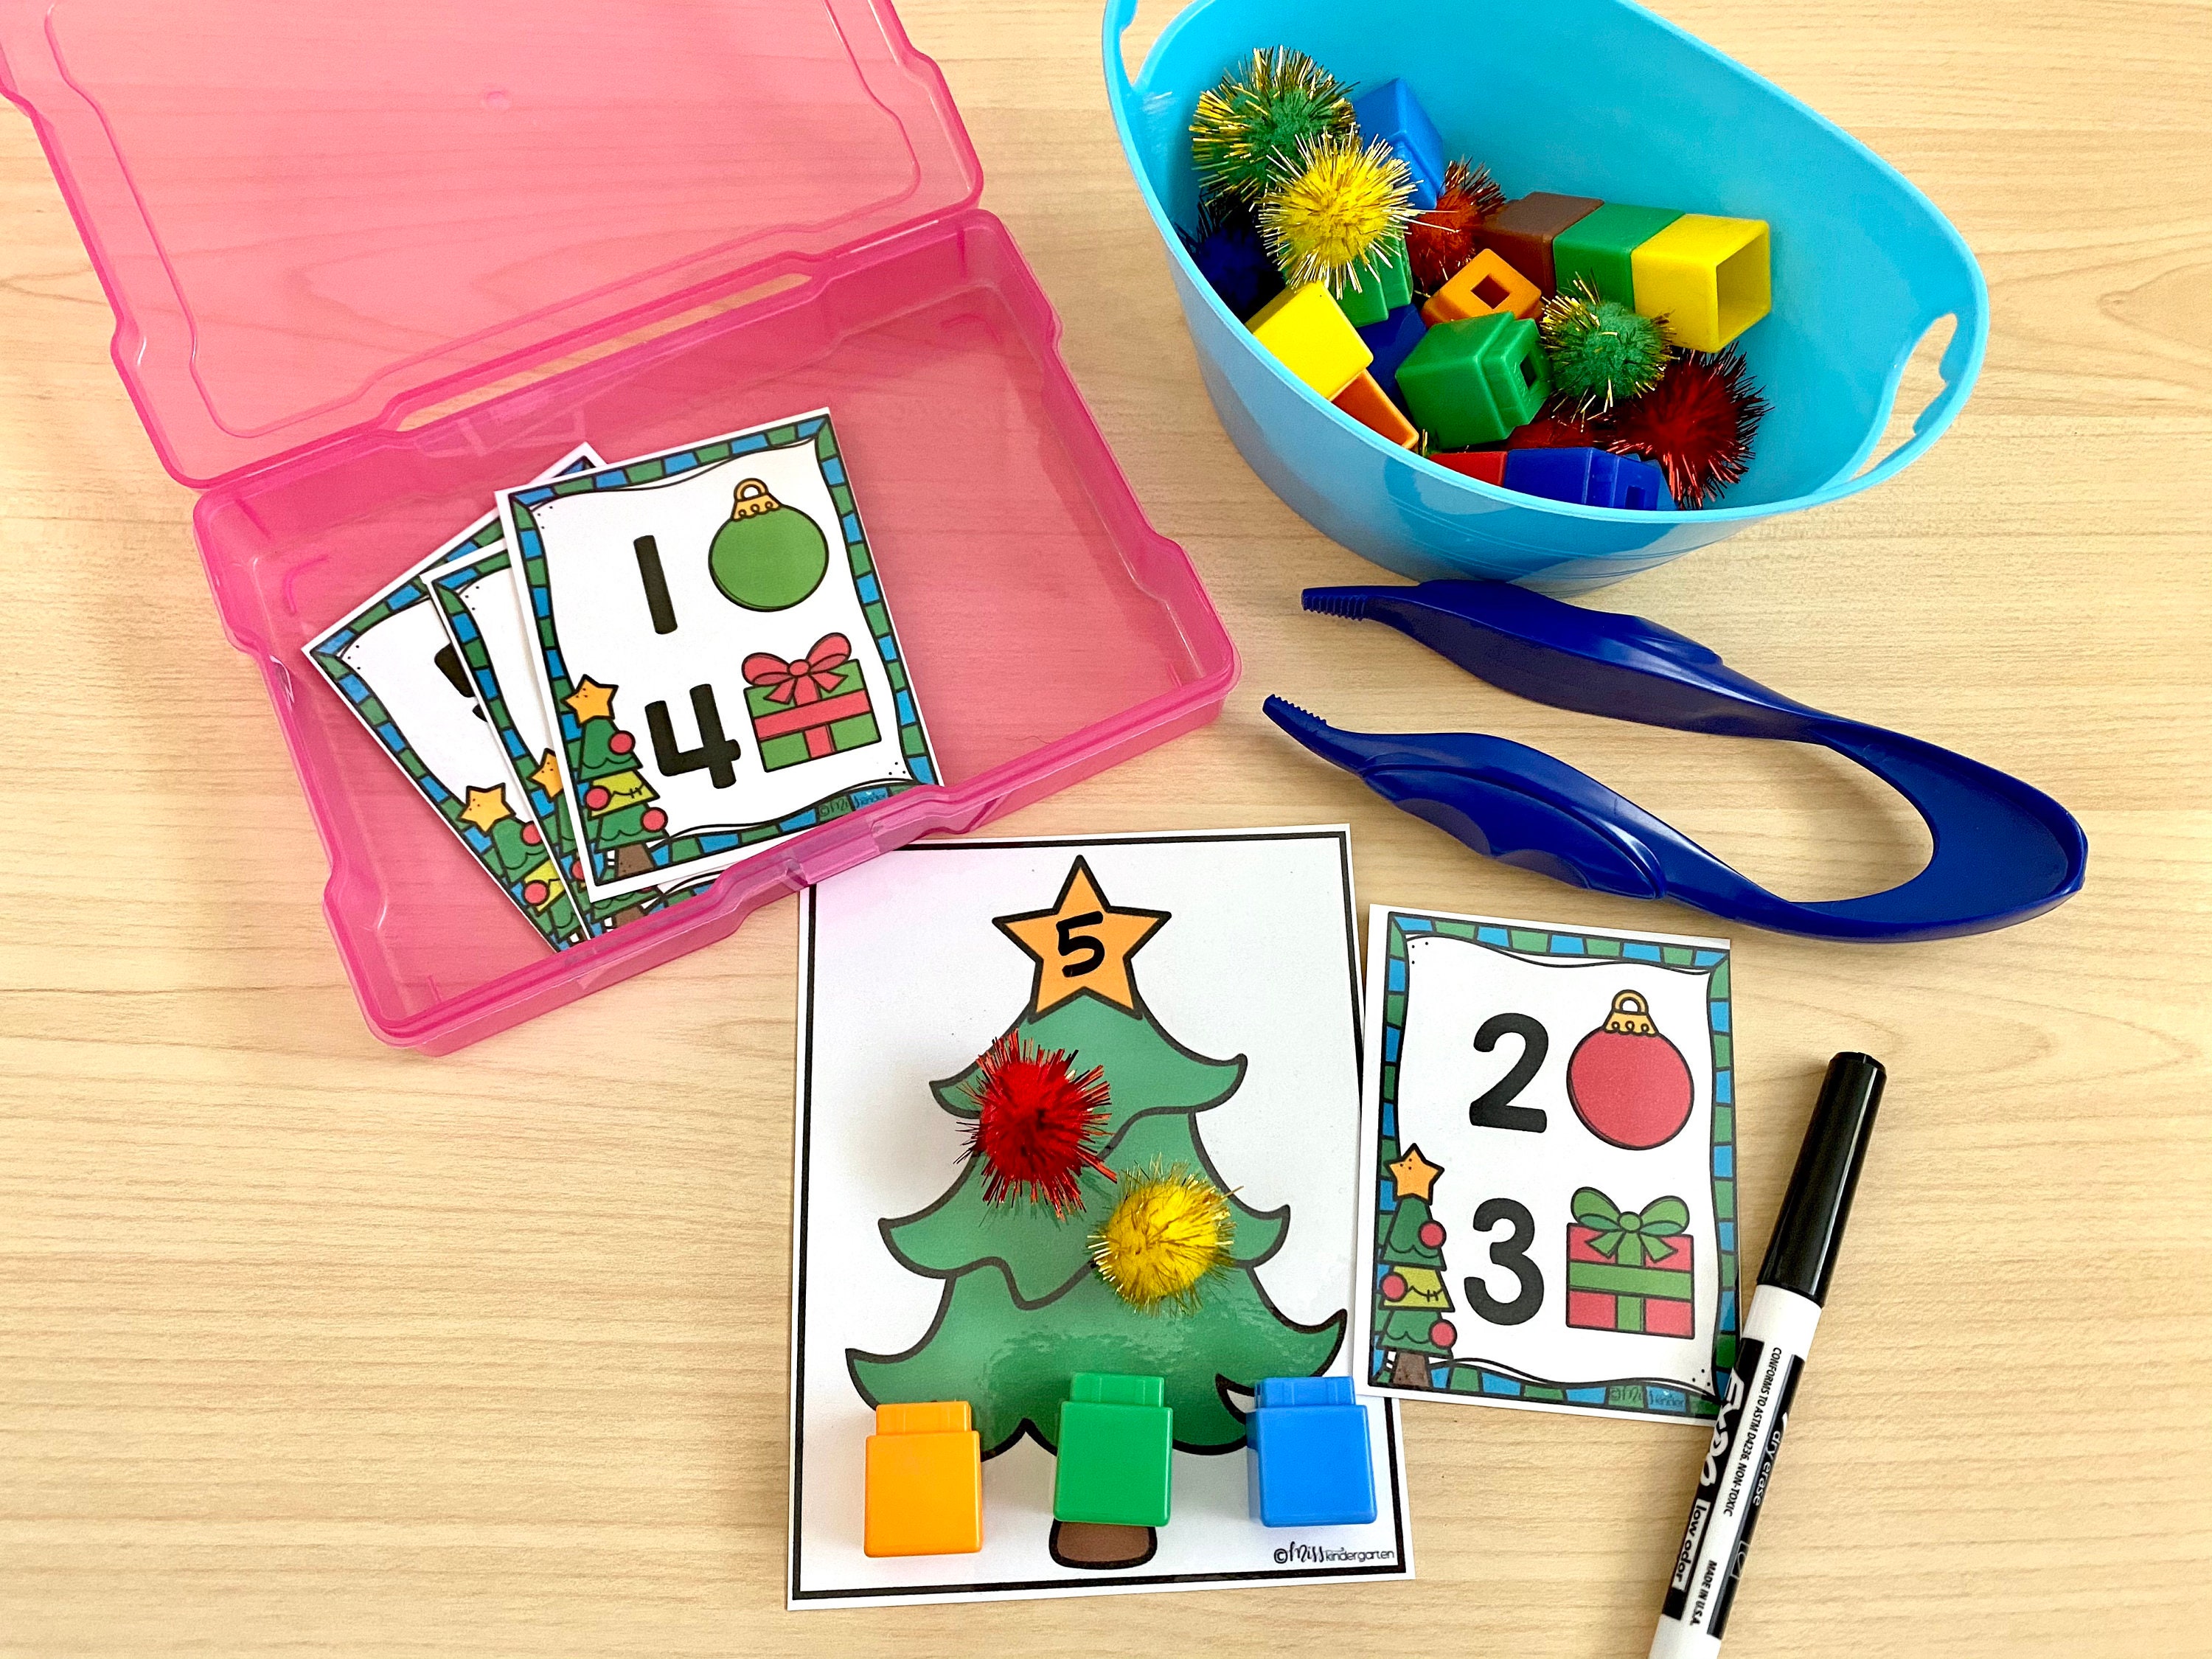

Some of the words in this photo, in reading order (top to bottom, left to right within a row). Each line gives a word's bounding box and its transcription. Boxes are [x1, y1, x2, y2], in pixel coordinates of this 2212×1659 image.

[633, 535, 678, 635] 1
[644, 684, 741, 790] 4
[1055, 911, 1105, 978] 5
[1469, 1012, 1549, 1133] 2
[1464, 1198, 1545, 1326] 3
[1761, 1347, 1781, 1394] CONFORMS
[1749, 1406, 1764, 1432] ASTM
[1757, 1395, 1768, 1407] TO
[1766, 1430, 1781, 1460] dry
[1723, 1462, 1747, 1517] NON-TOXIC
[1753, 1461, 1772, 1506] erase
[1689, 1505, 1707, 1537] low
[1676, 1540, 1692, 1582] odor
[1701, 1559, 1717, 1589] MADE
[1698, 1590, 1709, 1601] IN
